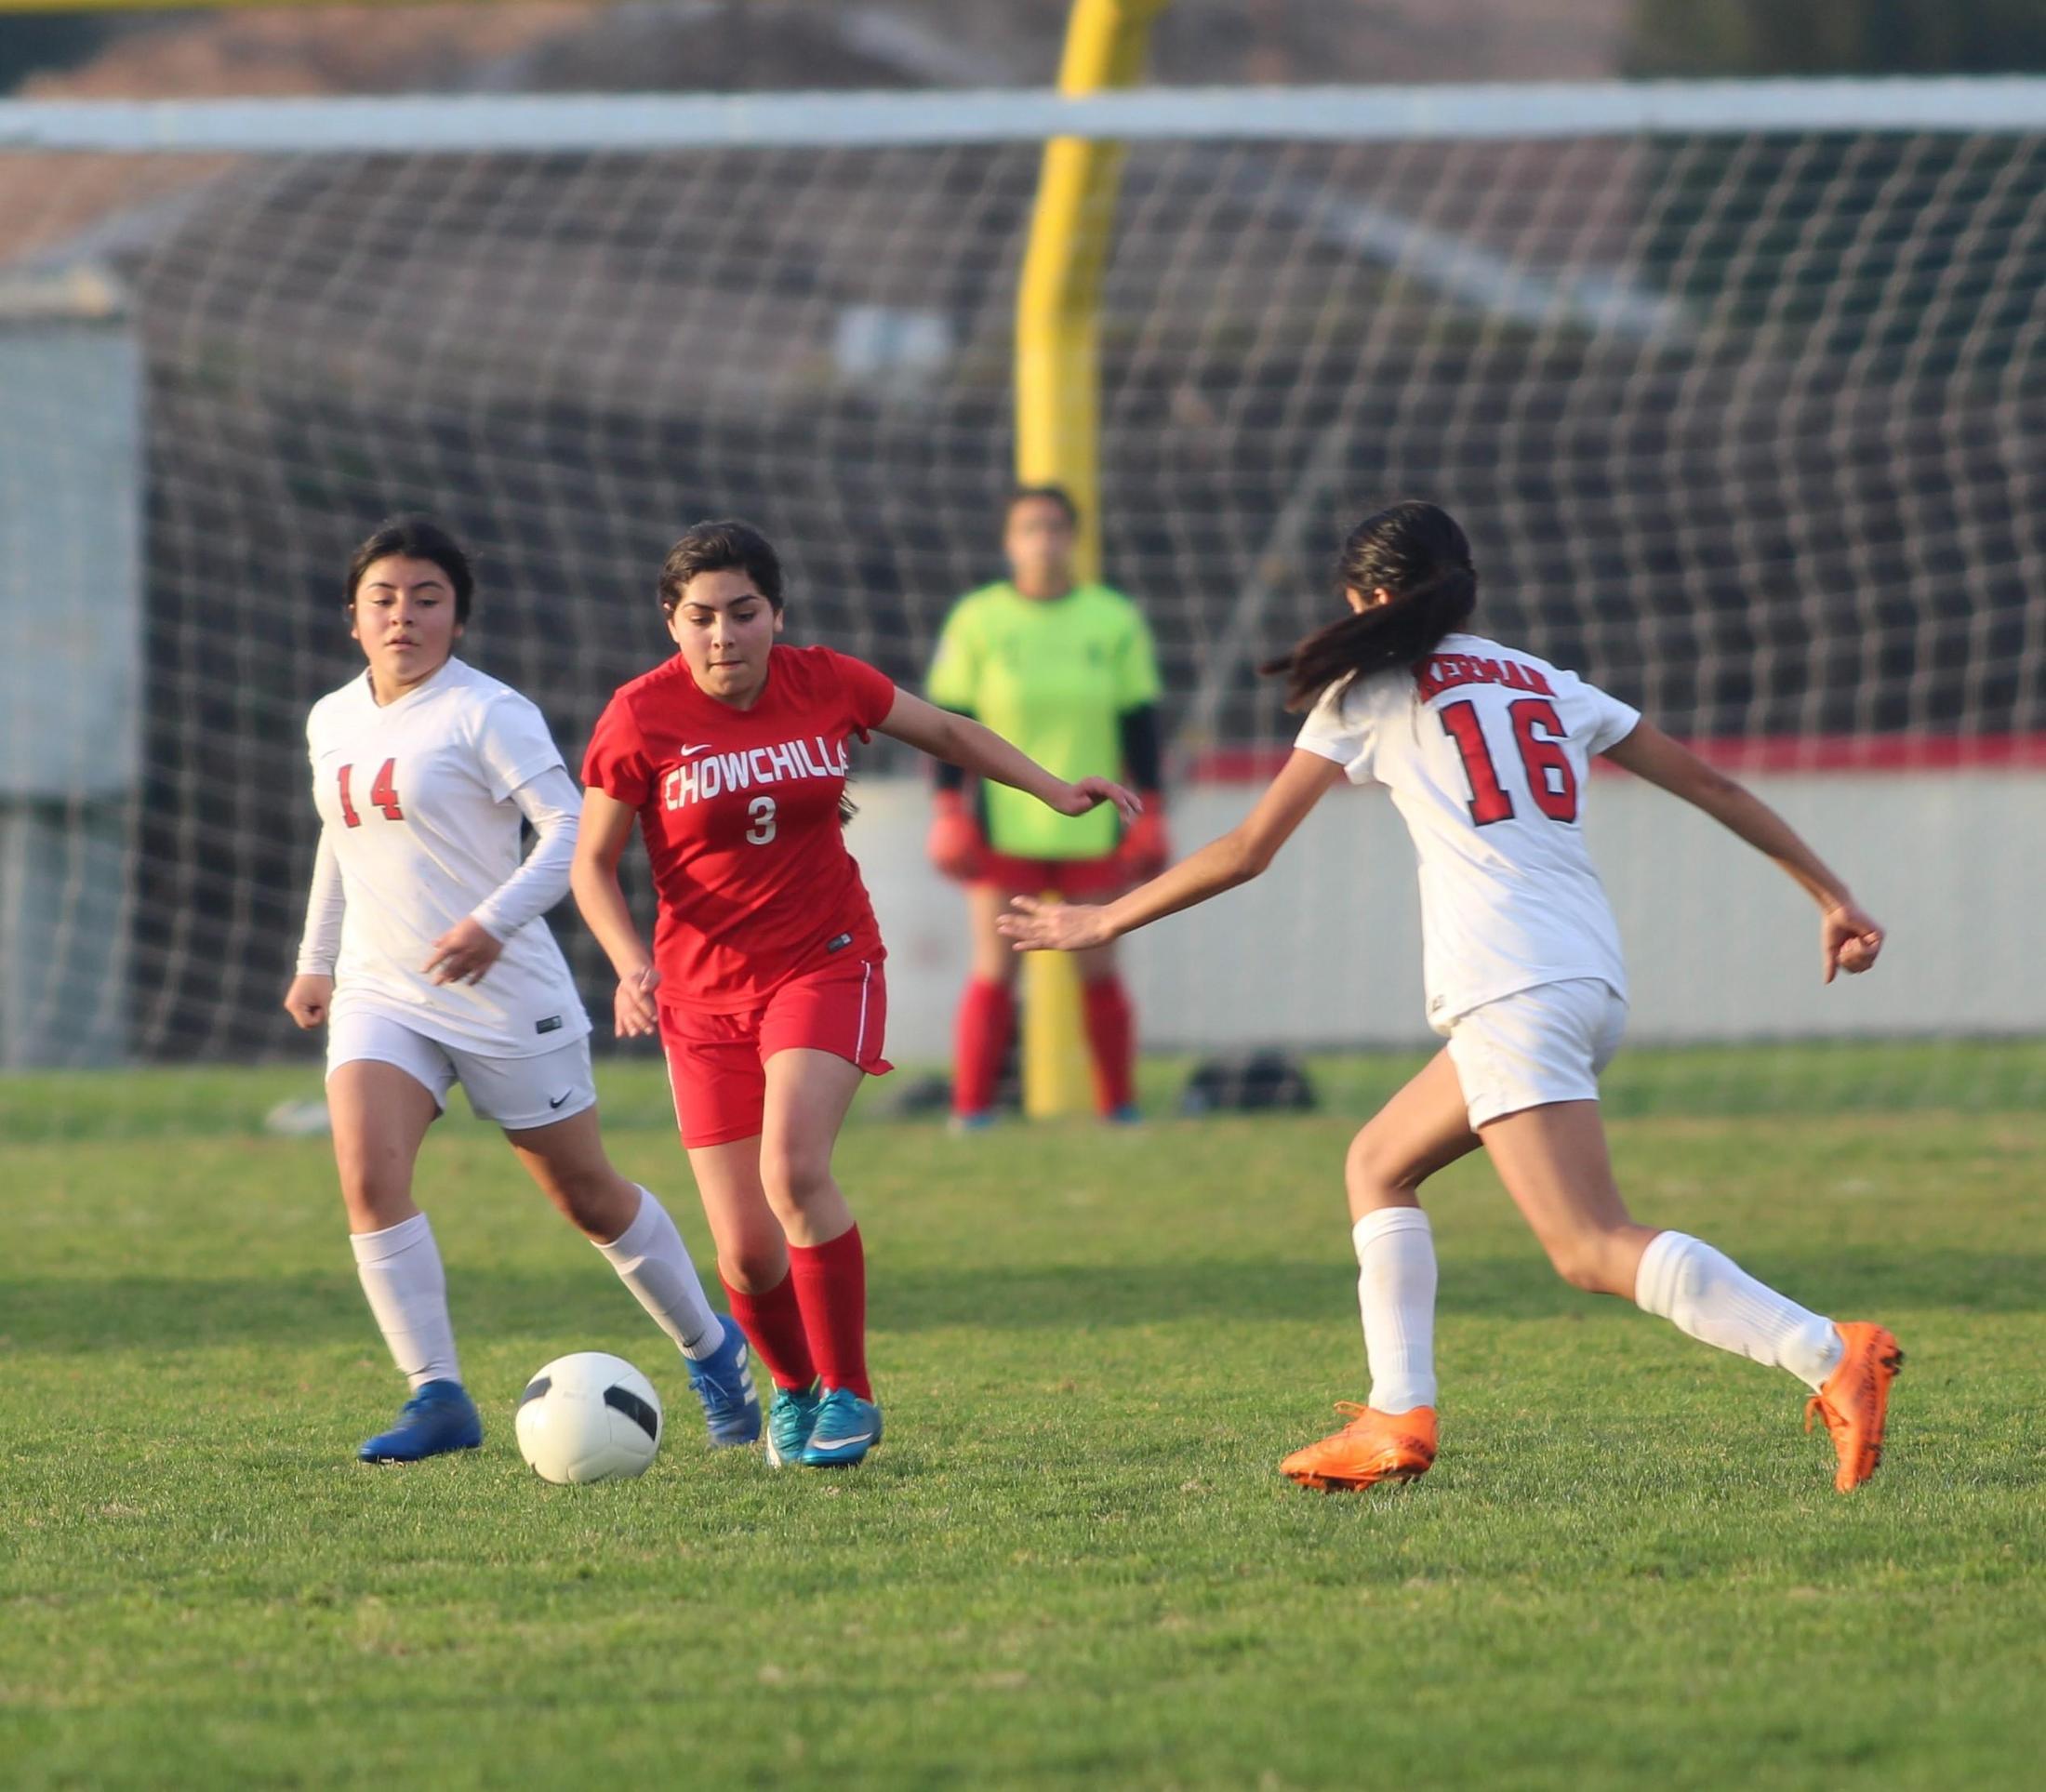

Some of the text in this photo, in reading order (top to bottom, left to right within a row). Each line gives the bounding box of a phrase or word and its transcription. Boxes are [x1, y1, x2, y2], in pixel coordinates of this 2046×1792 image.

[337, 757, 405, 829] 14
[1439, 698, 1577, 827] 16
[746, 795, 777, 844] 3
